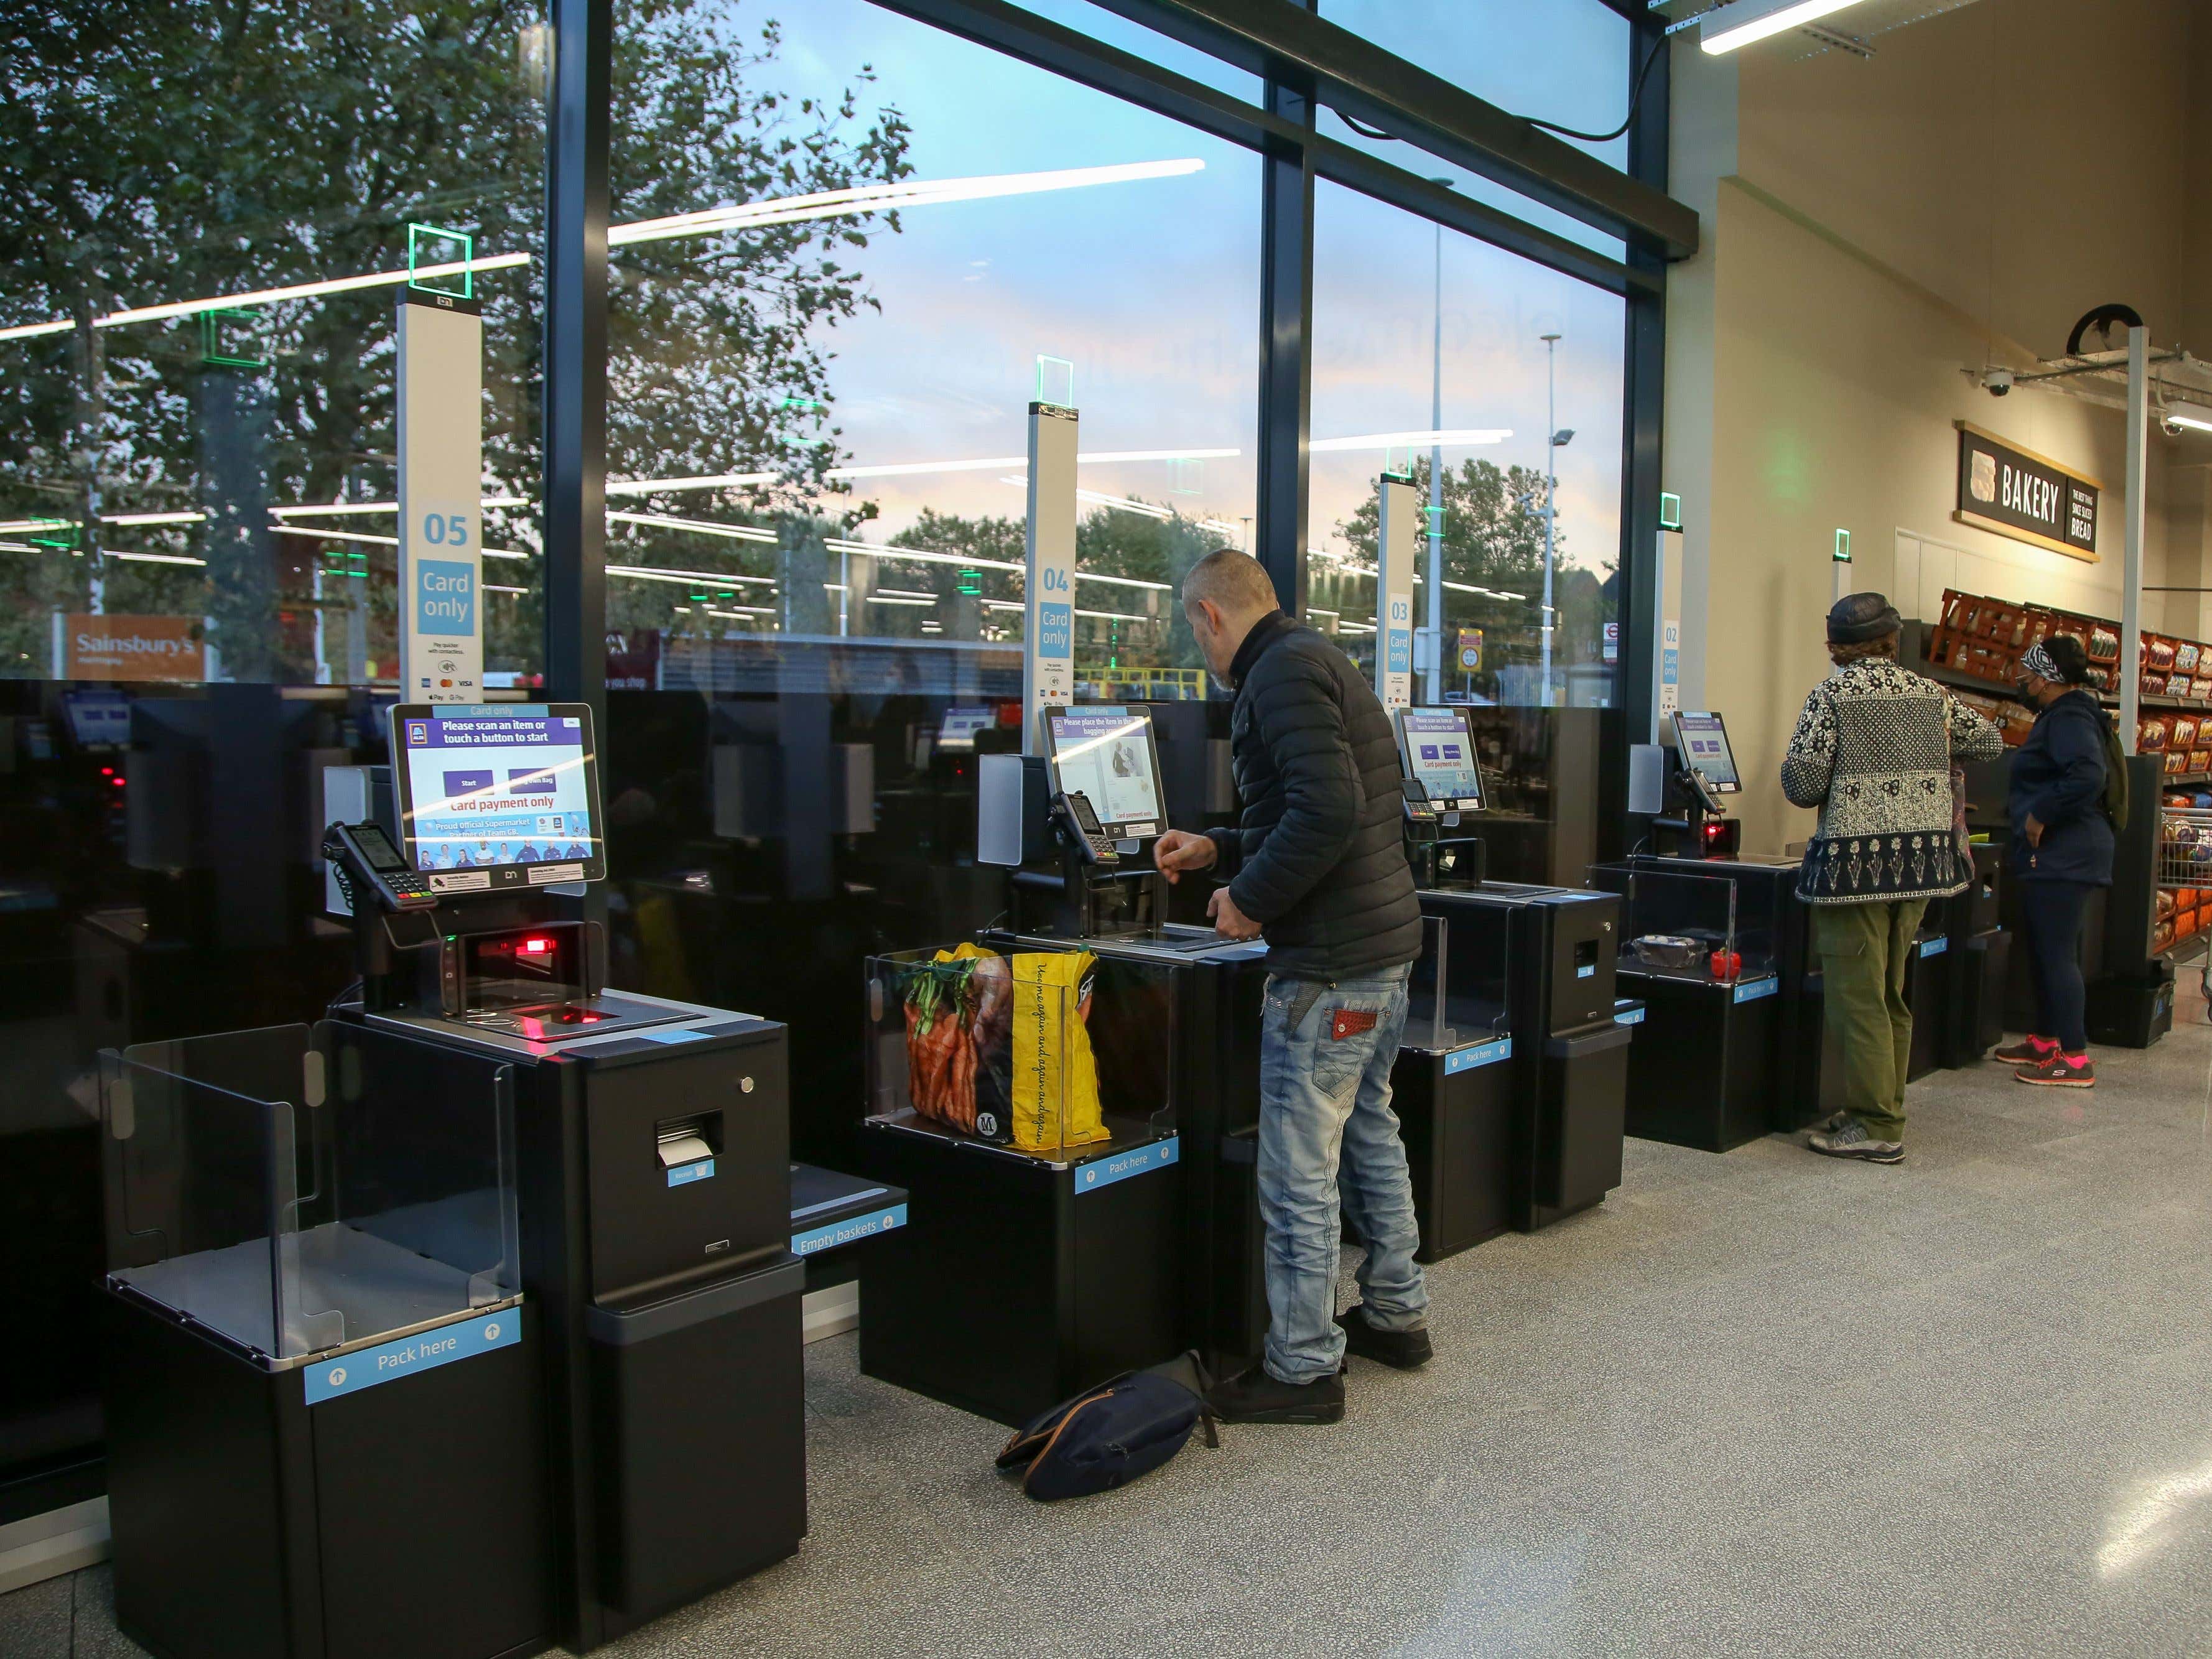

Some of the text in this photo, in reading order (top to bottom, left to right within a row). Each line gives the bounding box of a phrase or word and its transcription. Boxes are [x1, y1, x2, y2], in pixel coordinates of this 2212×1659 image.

[2002, 465, 2059, 524] BAKERY
[424, 513, 467, 546] 05
[2071, 518, 2091, 541] BREAD
[423, 572, 468, 593] Card
[1044, 567, 1068, 592] 04
[425, 598, 468, 622] only
[1043, 611, 1067, 627] Card
[1392, 602, 1407, 620] 03
[1043, 631, 1067, 649] only
[1391, 636, 1408, 648] Card
[1666, 627, 1676, 642] 02
[77, 633, 195, 657] Sainsbury's
[1391, 651, 1407, 665] only
[1665, 655, 1676, 664] Card
[1665, 666, 1676, 677] only
[470, 706, 514, 716] Card only
[442, 720, 545, 731] Please scan an item or
[1082, 718, 1095, 727] place
[1084, 727, 1105, 735] bagging
[444, 733, 472, 743] touch
[481, 733, 514, 743] button
[516, 733, 526, 741] to
[527, 733, 548, 741] start
[451, 796, 554, 812] Card payment only
[436, 818, 530, 831] Proud Official Supermarket
[1036, 983, 1044, 1002] me
[1032, 1004, 1046, 1036] again
[1038, 1036, 1051, 1057] and
[1467, 1050, 1492, 1061] Pack here
[1032, 1059, 1046, 1090] again
[1038, 1092, 1051, 1114] and
[1032, 1115, 1046, 1144] again
[1109, 1154, 1148, 1174] Pack here
[801, 1221, 876, 1253] Empty baskets
[378, 1338, 457, 1370] Pack here
